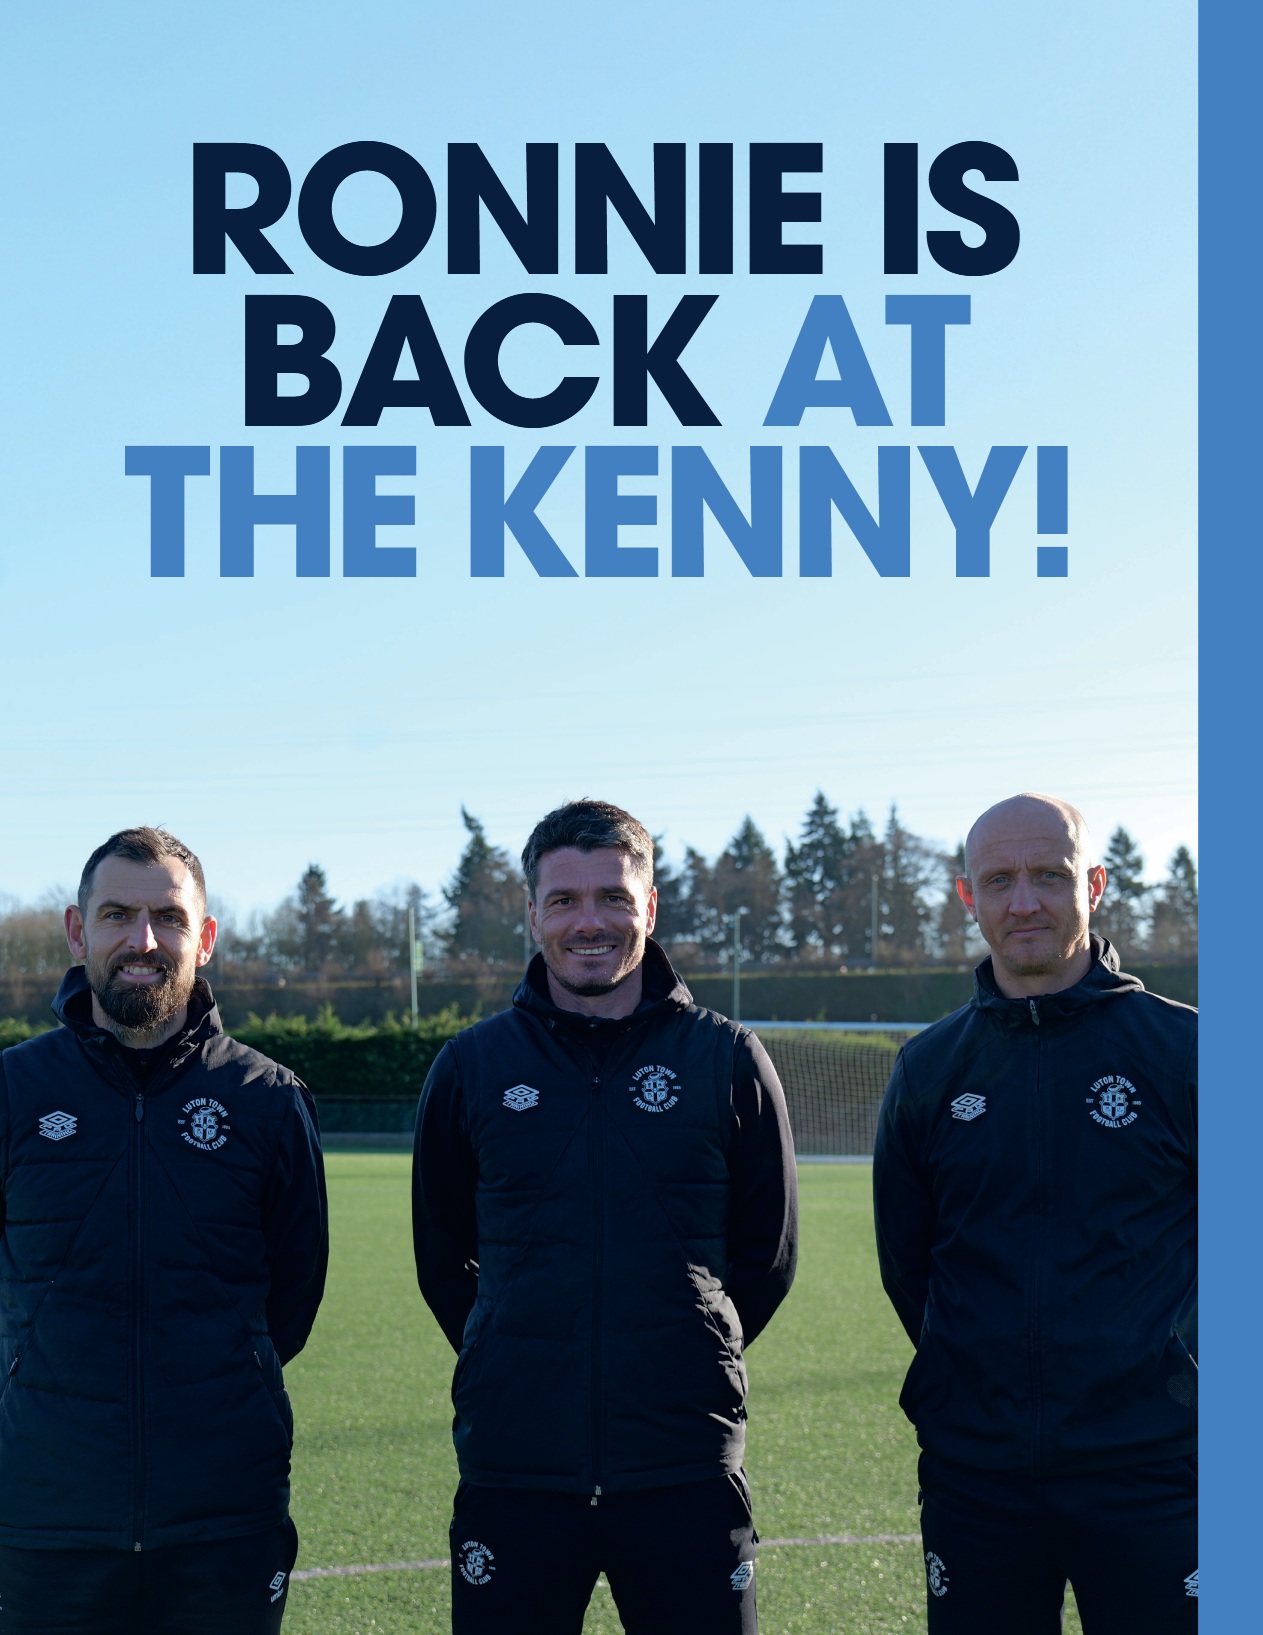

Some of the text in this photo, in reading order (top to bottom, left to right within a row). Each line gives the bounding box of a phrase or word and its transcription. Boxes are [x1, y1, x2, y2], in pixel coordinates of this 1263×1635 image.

[632, 1065, 677, 1081] LUTON TOWN
[1090, 1075, 1137, 1094] LUTON TOWN
[182, 1097, 229, 1118] LUTON TOWN
[633, 1095, 678, 1113] FOOTBALL CLUB
[1089, 1109, 1138, 1129] FOOTBALL CLUB
[181, 1131, 227, 1151] FOOTBALL CLUB
